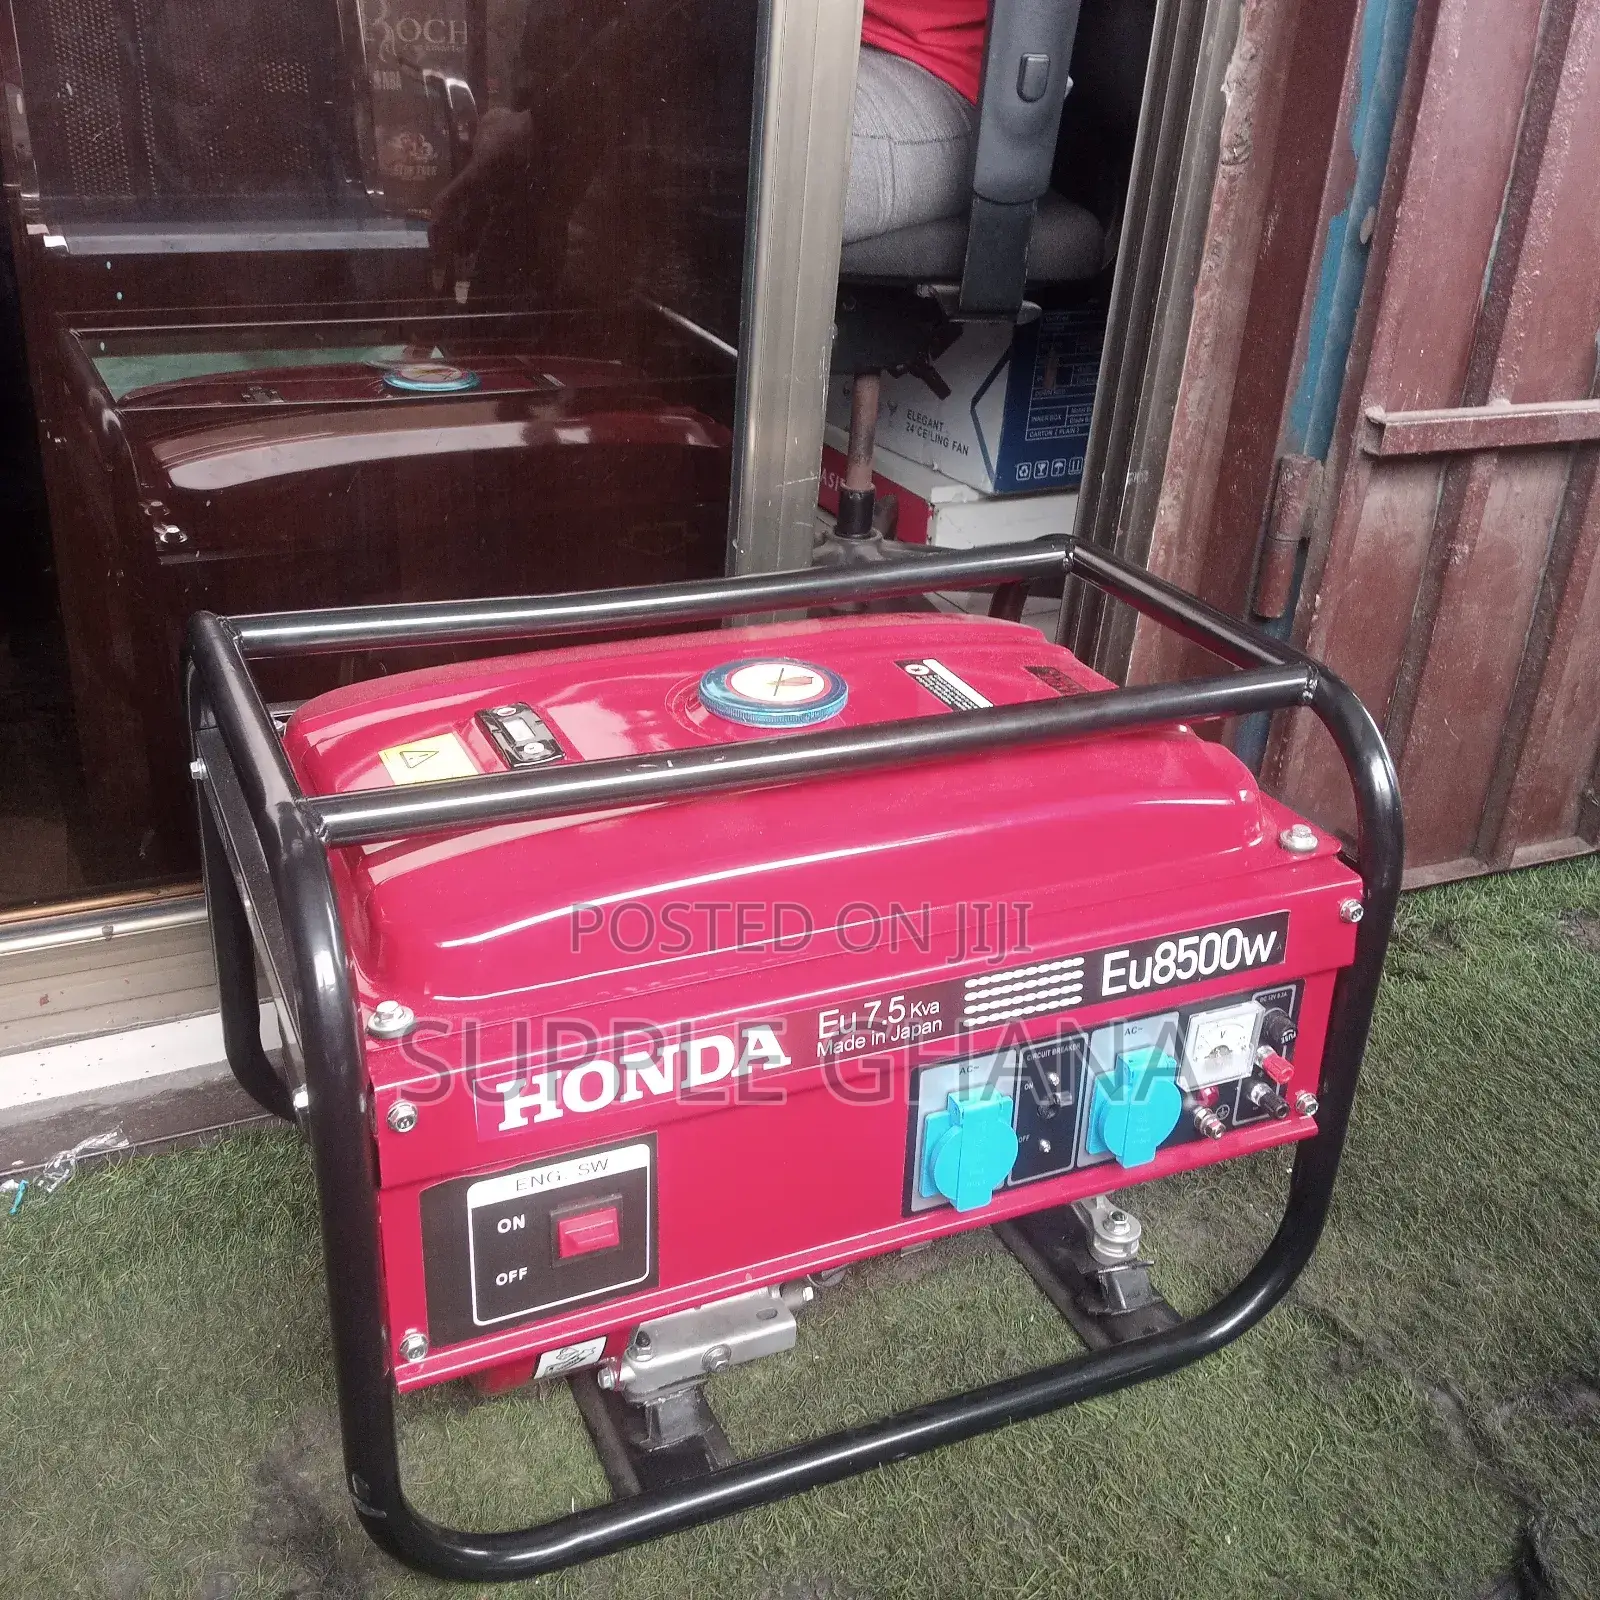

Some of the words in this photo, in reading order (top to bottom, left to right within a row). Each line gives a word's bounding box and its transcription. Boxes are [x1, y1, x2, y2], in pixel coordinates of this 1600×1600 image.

[906, 409, 944, 432] ELEGANT
[952, 440, 969, 456] FAN
[1101, 927, 1278, 997] Eu8500w
[818, 1008, 857, 1040] Eu
[863, 995, 906, 1029] 7.5
[910, 1000, 940, 1019] Kva
[816, 1034, 867, 1058] Made
[871, 1029, 886, 1046] in
[890, 1018, 943, 1042] Japan
[1026, 1049, 1050, 1062] CIRCUIT
[1051, 1042, 1081, 1056] BREAKER
[498, 1025, 792, 1131] HONDA
[1024, 1081, 1034, 1091] ON
[1018, 1134, 1031, 1143] OFF
[578, 1158, 610, 1178] SW
[496, 1213, 527, 1235] ON
[495, 1266, 529, 1286] OFF
